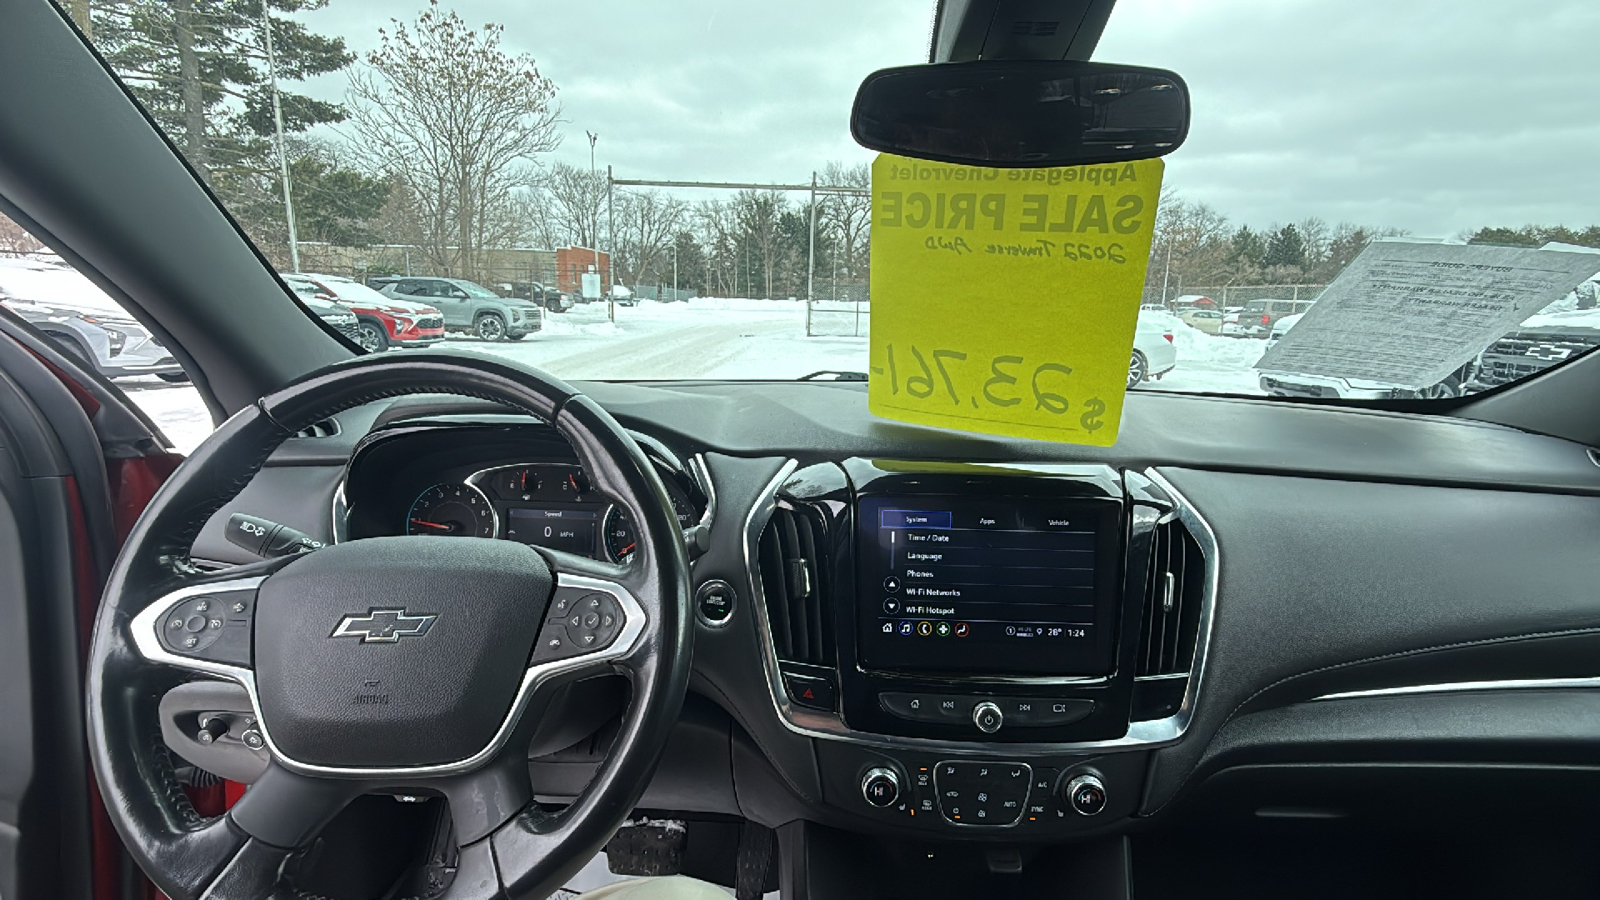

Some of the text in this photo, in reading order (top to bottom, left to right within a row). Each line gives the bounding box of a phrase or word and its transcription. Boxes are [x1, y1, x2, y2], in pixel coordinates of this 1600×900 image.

[906, 516, 928, 524] System
[979, 517, 996, 526] Apps
[544, 526, 552, 538] 0
[907, 533, 926, 541] Time
[932, 534, 950, 542] Date
[907, 551, 943, 562] Language
[906, 569, 934, 578] Phones
[926, 588, 961, 597] Networks
[926, 606, 955, 616] Hotspot
[1067, 629, 1085, 638] 1:24
